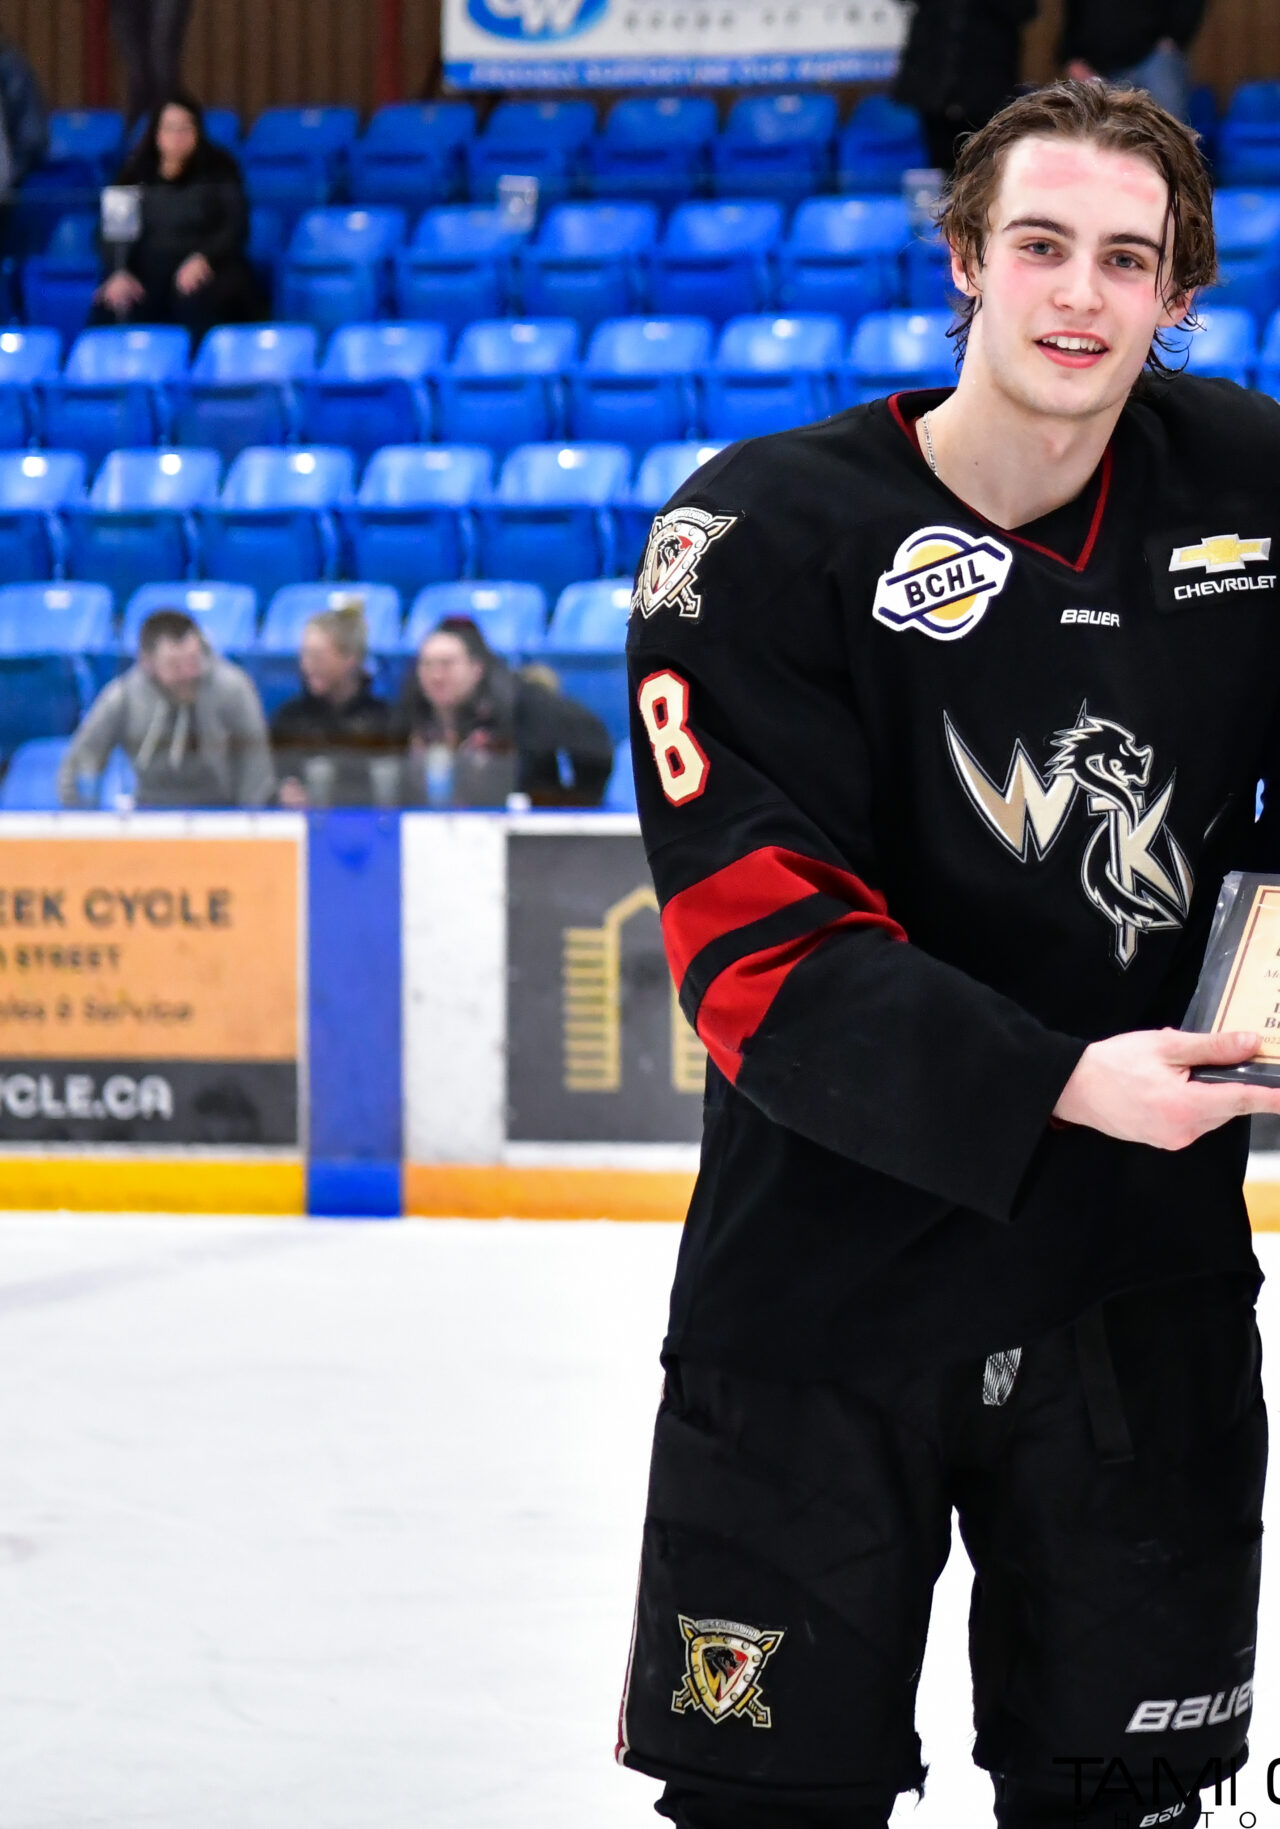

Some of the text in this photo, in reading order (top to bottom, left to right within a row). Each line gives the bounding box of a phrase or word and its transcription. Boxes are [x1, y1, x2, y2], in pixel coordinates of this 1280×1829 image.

[904, 559, 985, 608] BCHL
[1174, 575, 1277, 600] CHEVROLET
[636, 669, 710, 808] 8
[84, 887, 233, 931] CYCLE
[0, 1073, 174, 1121] CLE.CA
[1125, 1678, 1253, 1733] BAUE
